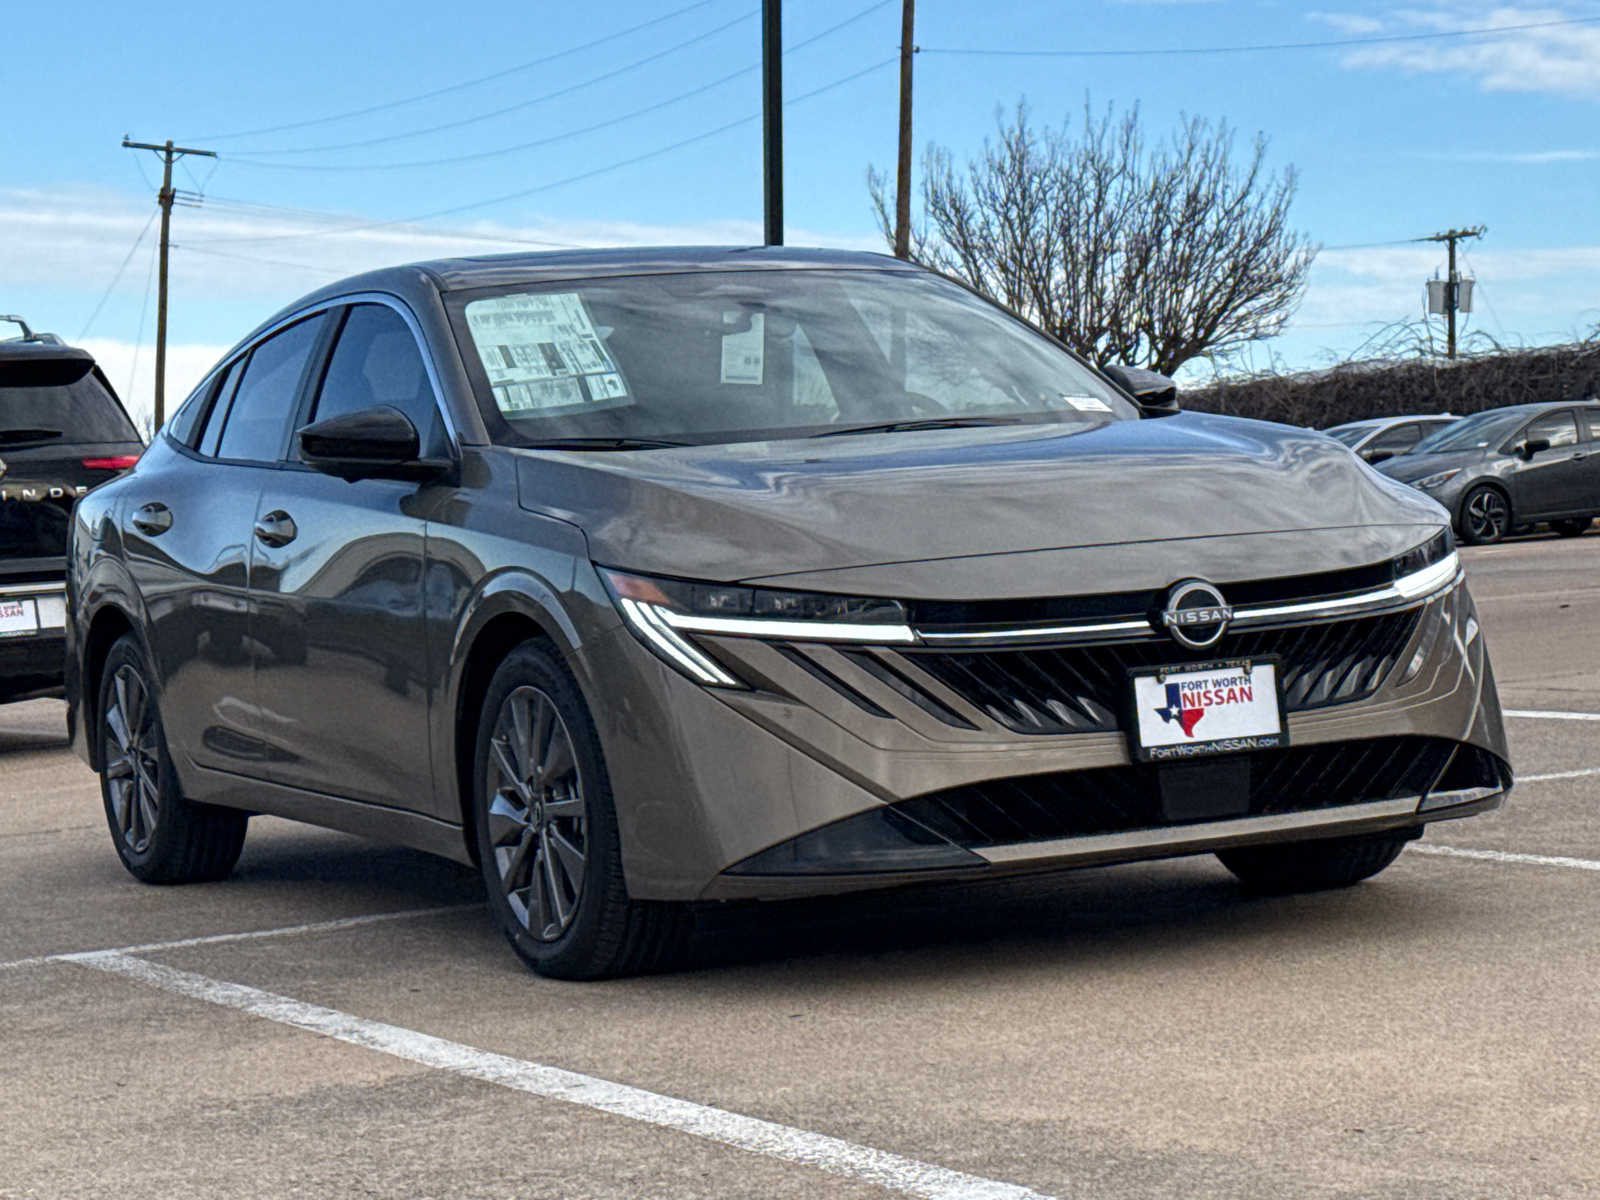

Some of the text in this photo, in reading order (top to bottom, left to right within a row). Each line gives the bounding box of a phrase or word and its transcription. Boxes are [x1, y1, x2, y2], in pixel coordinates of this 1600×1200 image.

[1165, 608, 1232, 624] NISSAN
[1160, 665, 1182, 674] FORT
[1184, 662, 1214, 671] WORTH
[1181, 676, 1251, 691] FORT WORTH
[1182, 686, 1252, 708] NISSAN
